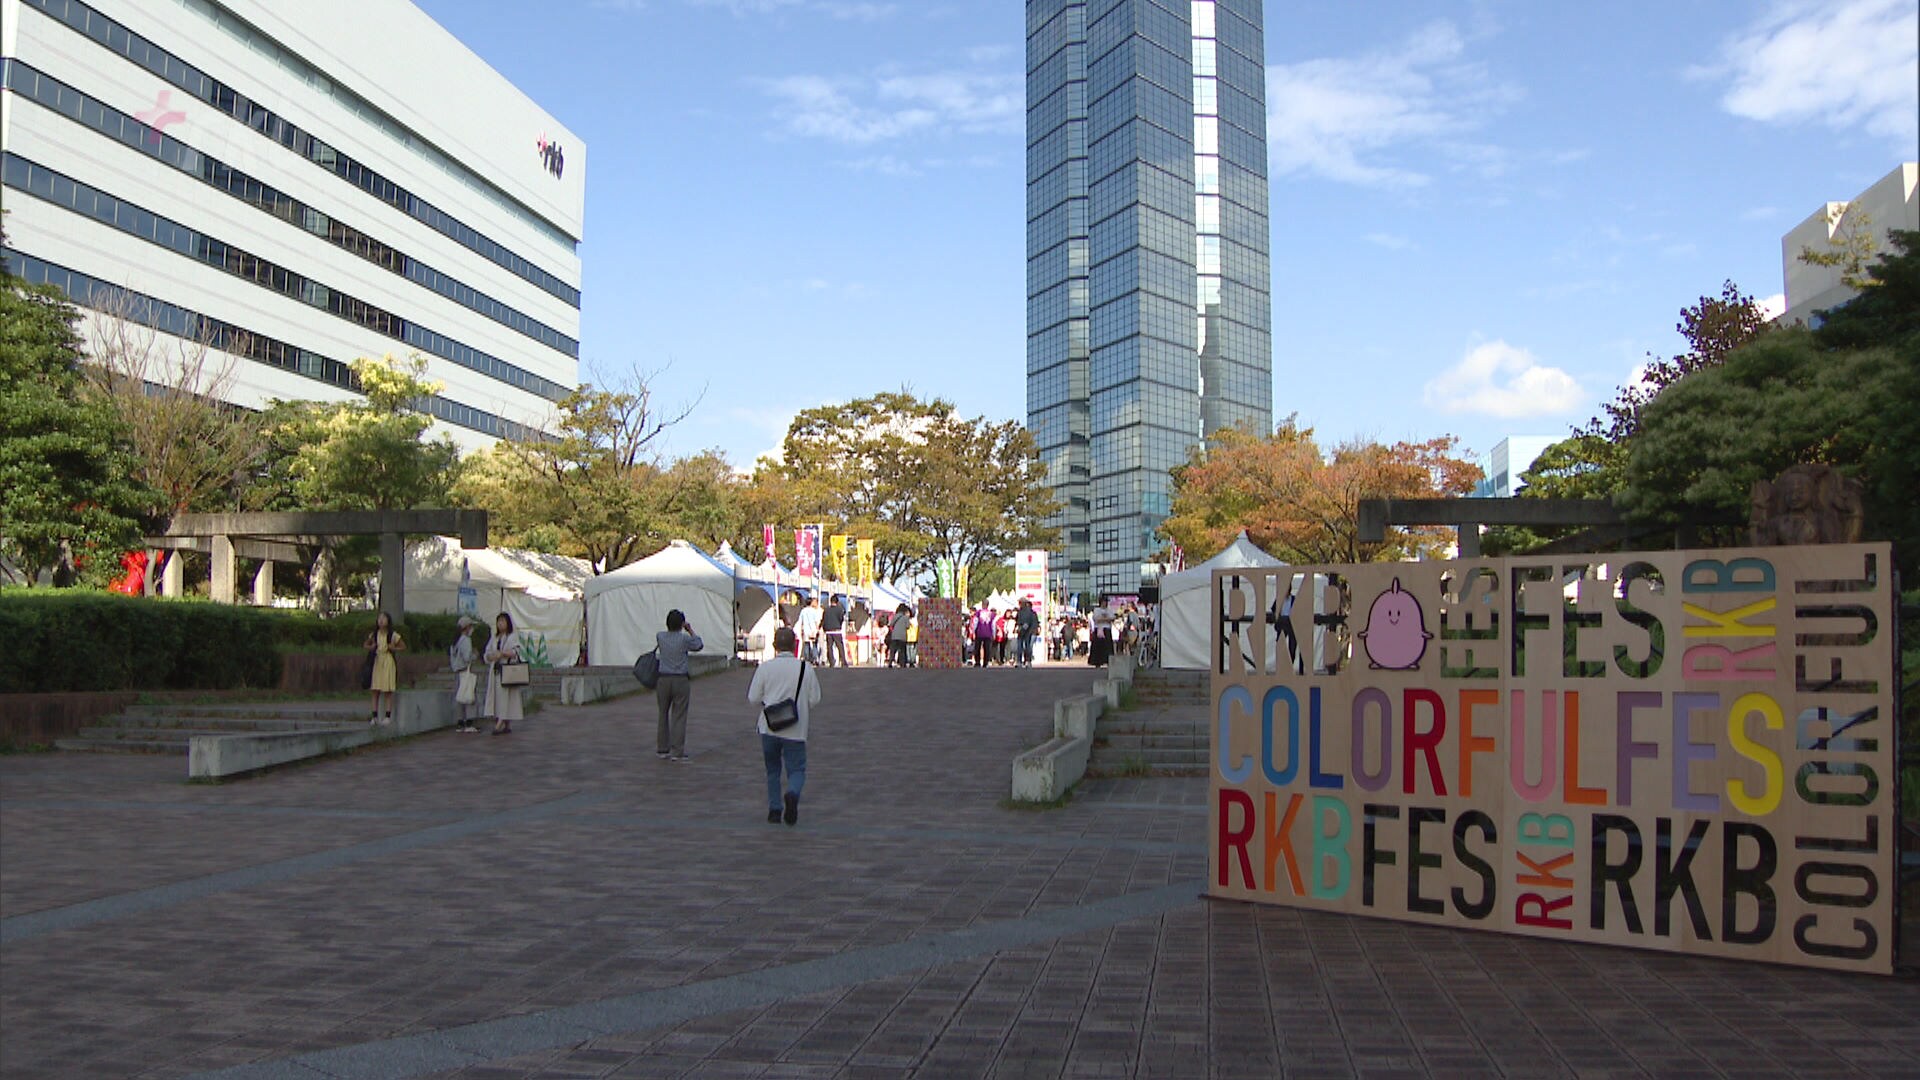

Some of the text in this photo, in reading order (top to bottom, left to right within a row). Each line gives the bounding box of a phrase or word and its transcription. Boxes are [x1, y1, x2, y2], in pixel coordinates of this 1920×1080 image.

[1219, 573, 1353, 675] RKB
[1440, 567, 1499, 678] FES
[1511, 561, 1665, 679] FES
[1682, 557, 1777, 680] RKB
[1794, 553, 1879, 961] COLORFUL
[1515, 813, 1576, 930] RKB
[1591, 813, 1777, 945] RKB
